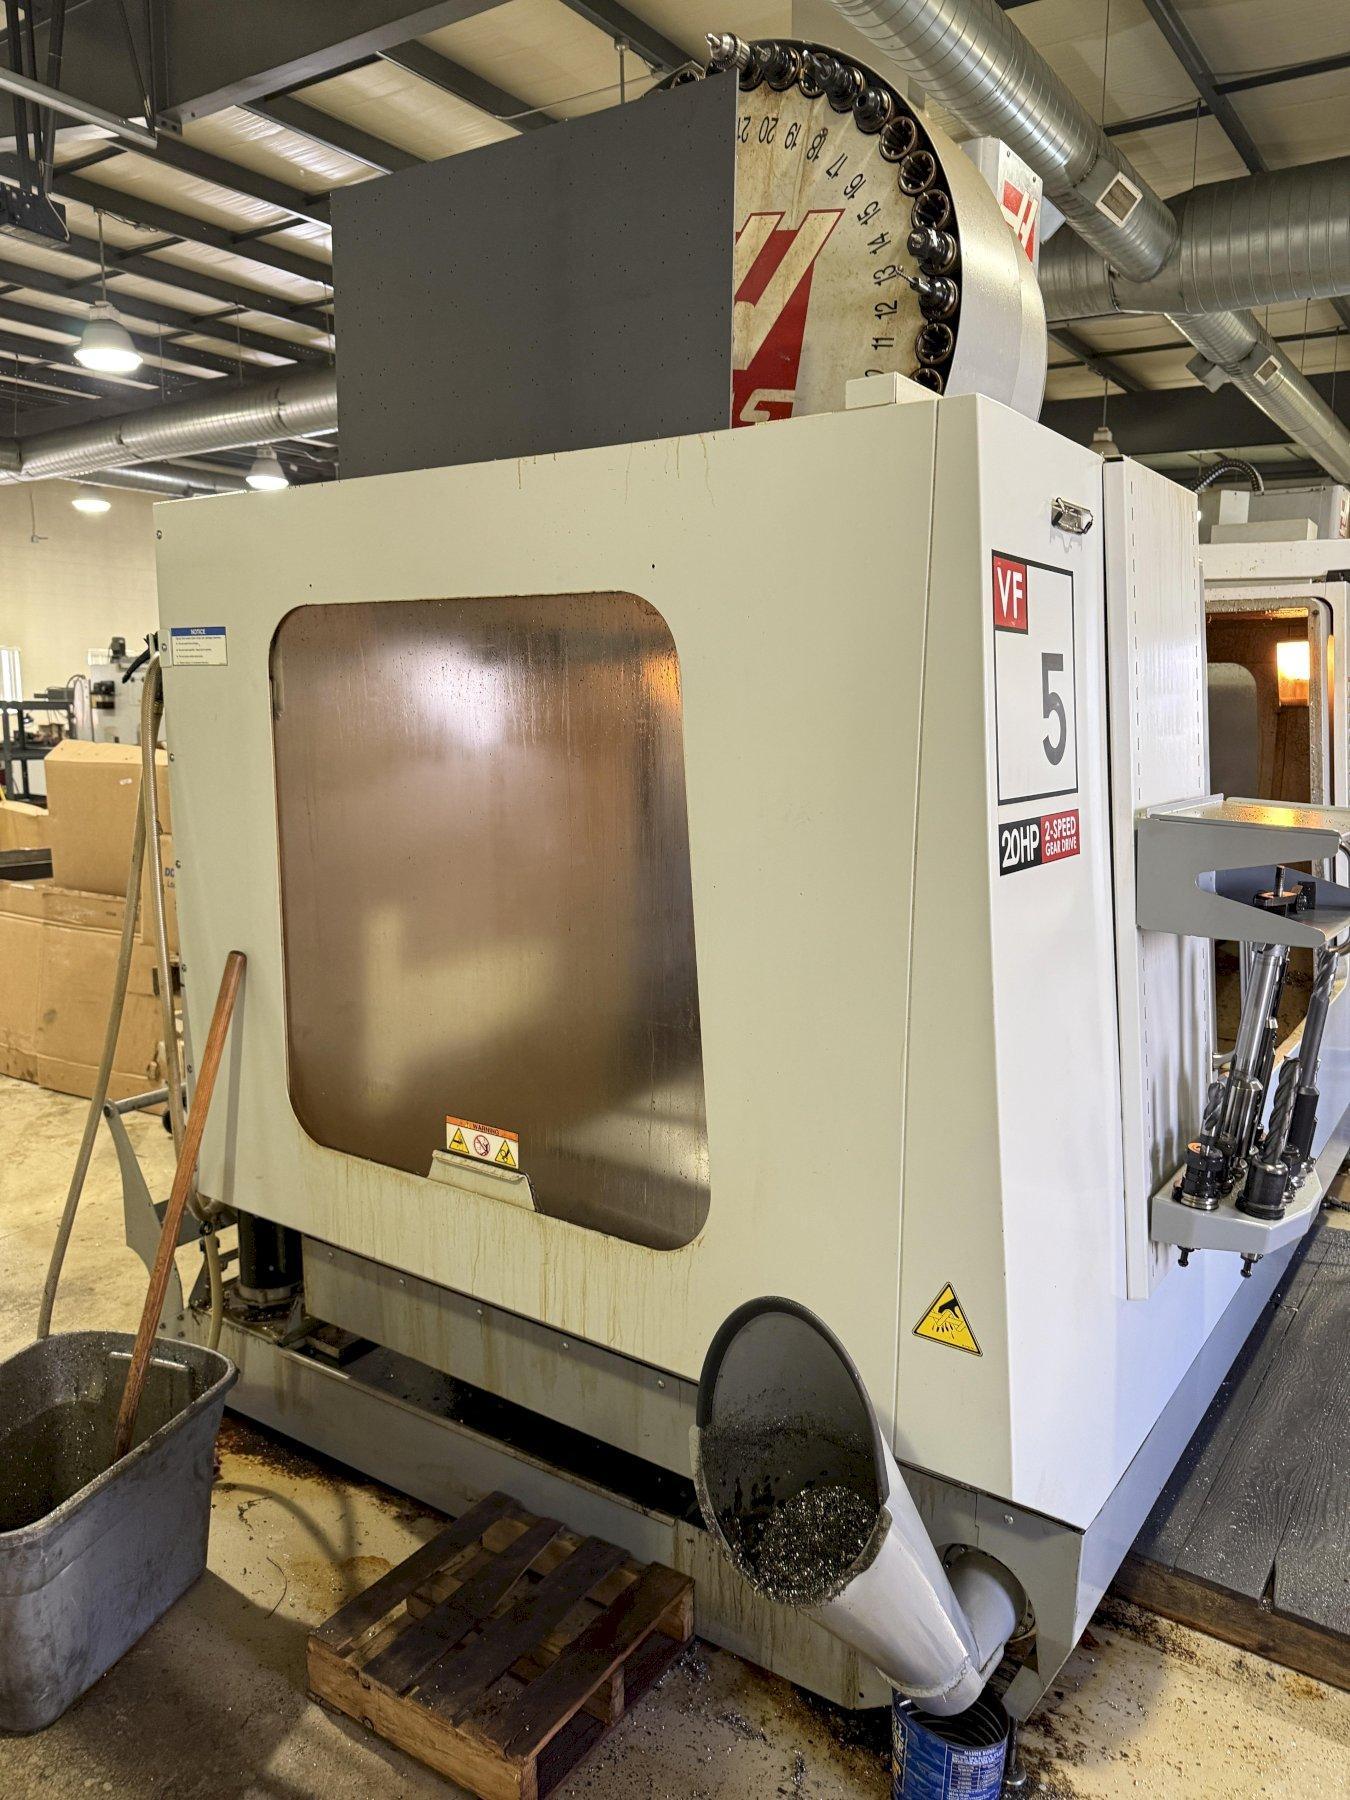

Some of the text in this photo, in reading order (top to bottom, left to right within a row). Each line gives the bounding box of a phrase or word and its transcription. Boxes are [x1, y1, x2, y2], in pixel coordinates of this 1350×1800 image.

[758, 116, 779, 144] 20
[784, 122, 801, 150] 19
[806, 133, 827, 162] 18
[826, 153, 848, 179] 17
[843, 173, 867, 200] 16
[856, 201, 881, 226] 15
[867, 232, 891, 255] 14
[873, 264, 897, 286] 13
[874, 300, 898, 320] 12
[871, 337, 895, 350] 11
[997, 566, 1023, 619] VF
[1041, 652, 1067, 765] 5
[1045, 816, 1076, 841] 2-SPEED
[1002, 824, 1040, 868] 20HP
[1045, 836, 1077, 857] GEAR DRIVE
[472, 1124, 500, 1135] WARNING
